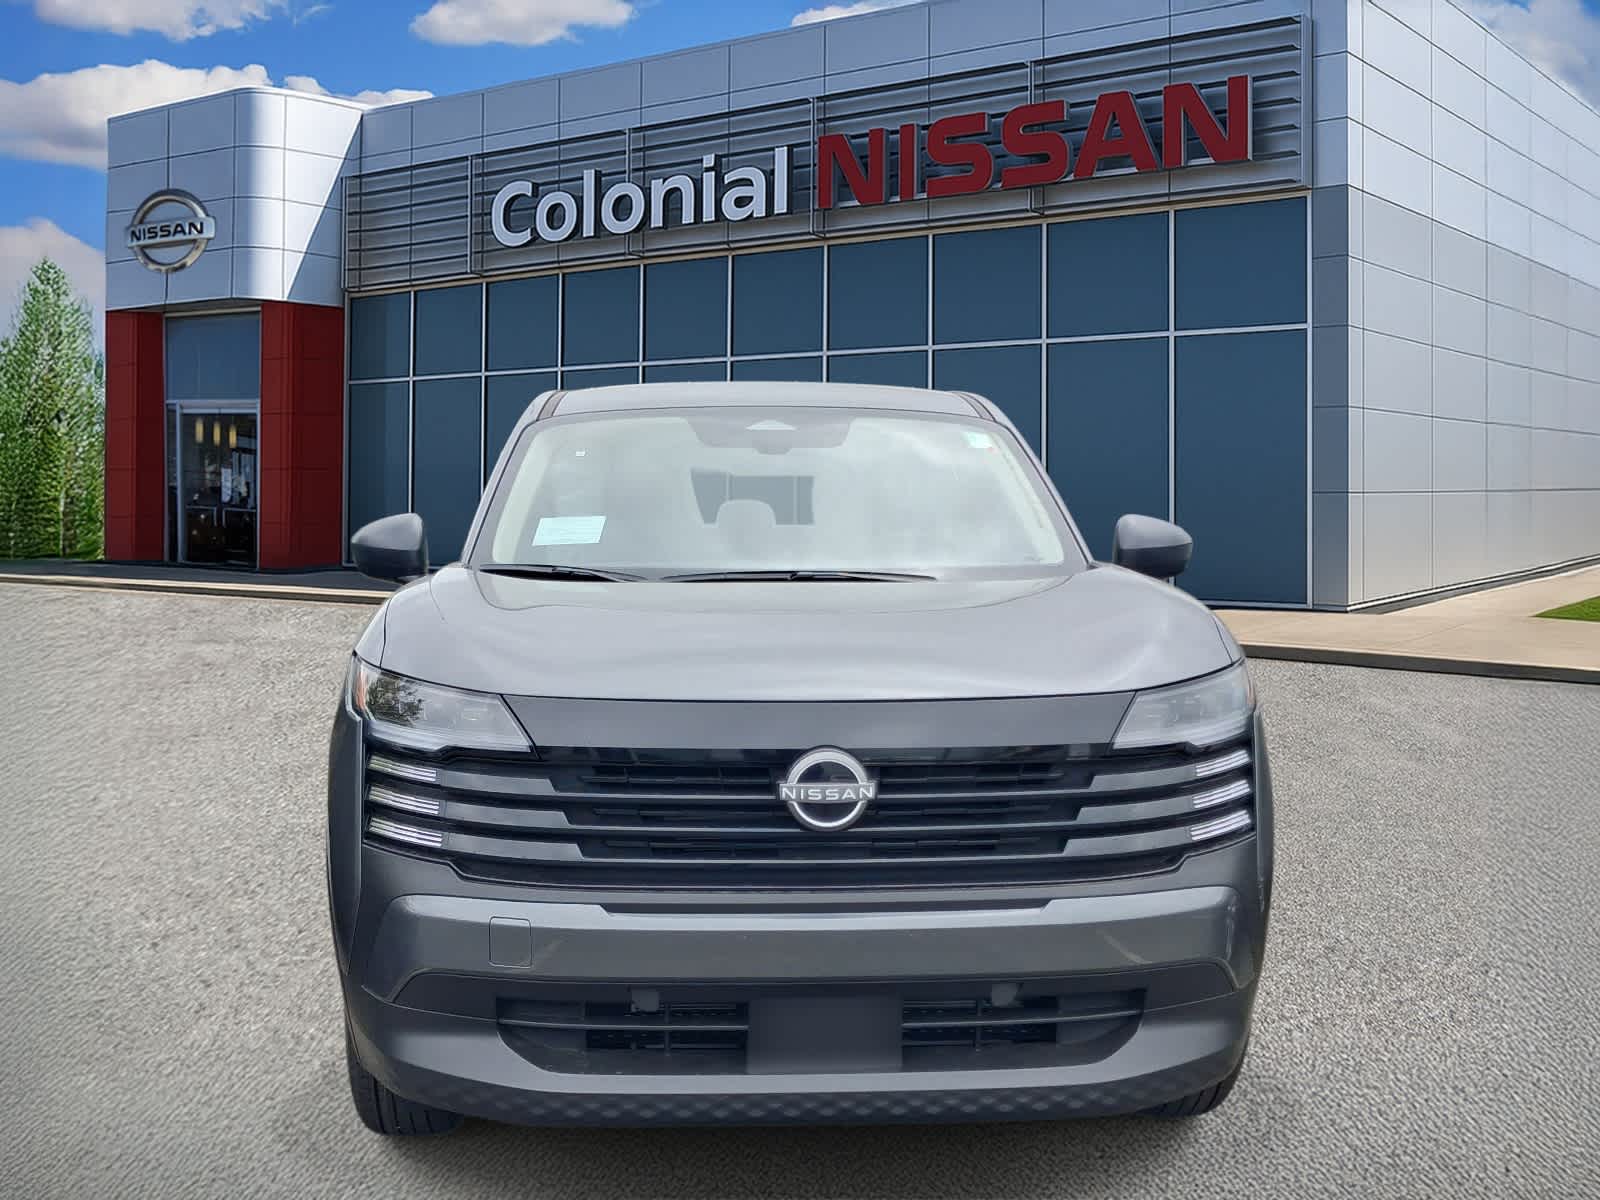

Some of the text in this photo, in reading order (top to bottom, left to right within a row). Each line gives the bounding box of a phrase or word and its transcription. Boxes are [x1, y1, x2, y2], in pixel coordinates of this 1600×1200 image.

[490, 75, 1253, 247] Colonial NISSAN
[130, 221, 204, 242] NISSAN
[781, 786, 873, 801] NISSAN
